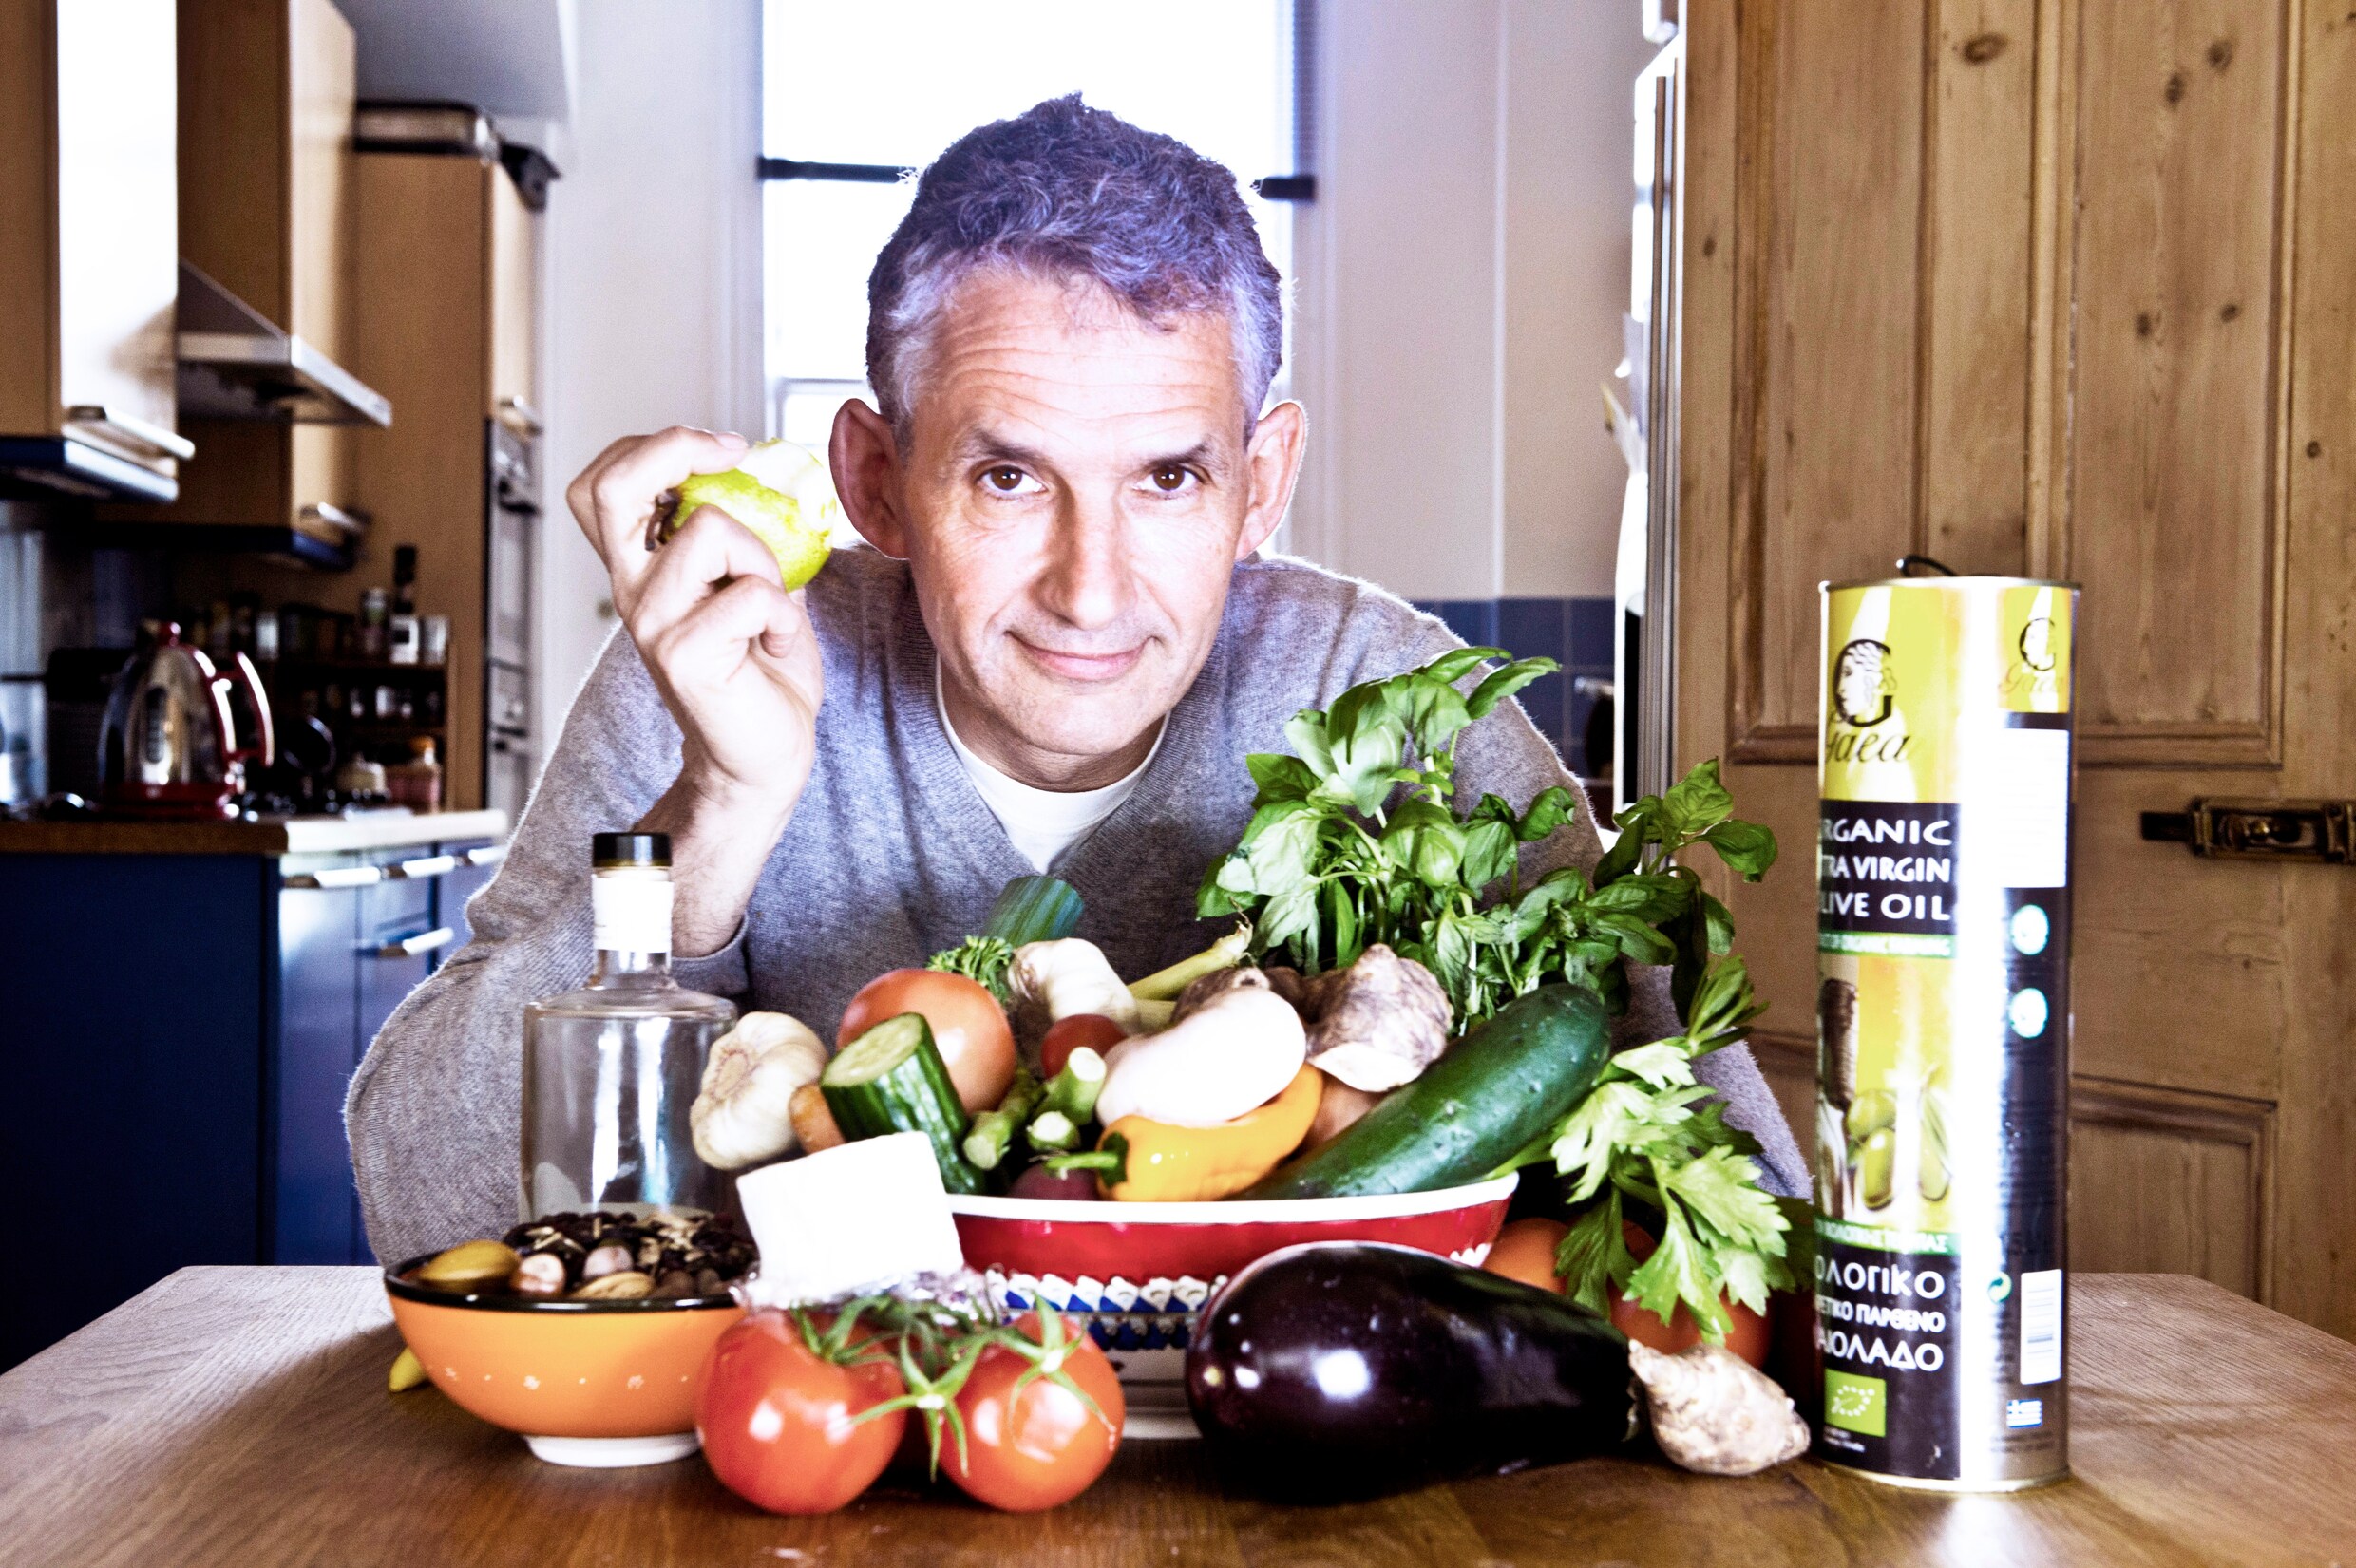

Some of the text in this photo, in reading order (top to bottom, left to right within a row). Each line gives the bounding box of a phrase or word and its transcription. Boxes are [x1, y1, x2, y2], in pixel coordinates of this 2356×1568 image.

[1821, 818, 1952, 846] RGANIC
[1852, 855, 1951, 883] VIRGIN
[1880, 893, 1951, 921] OIL
